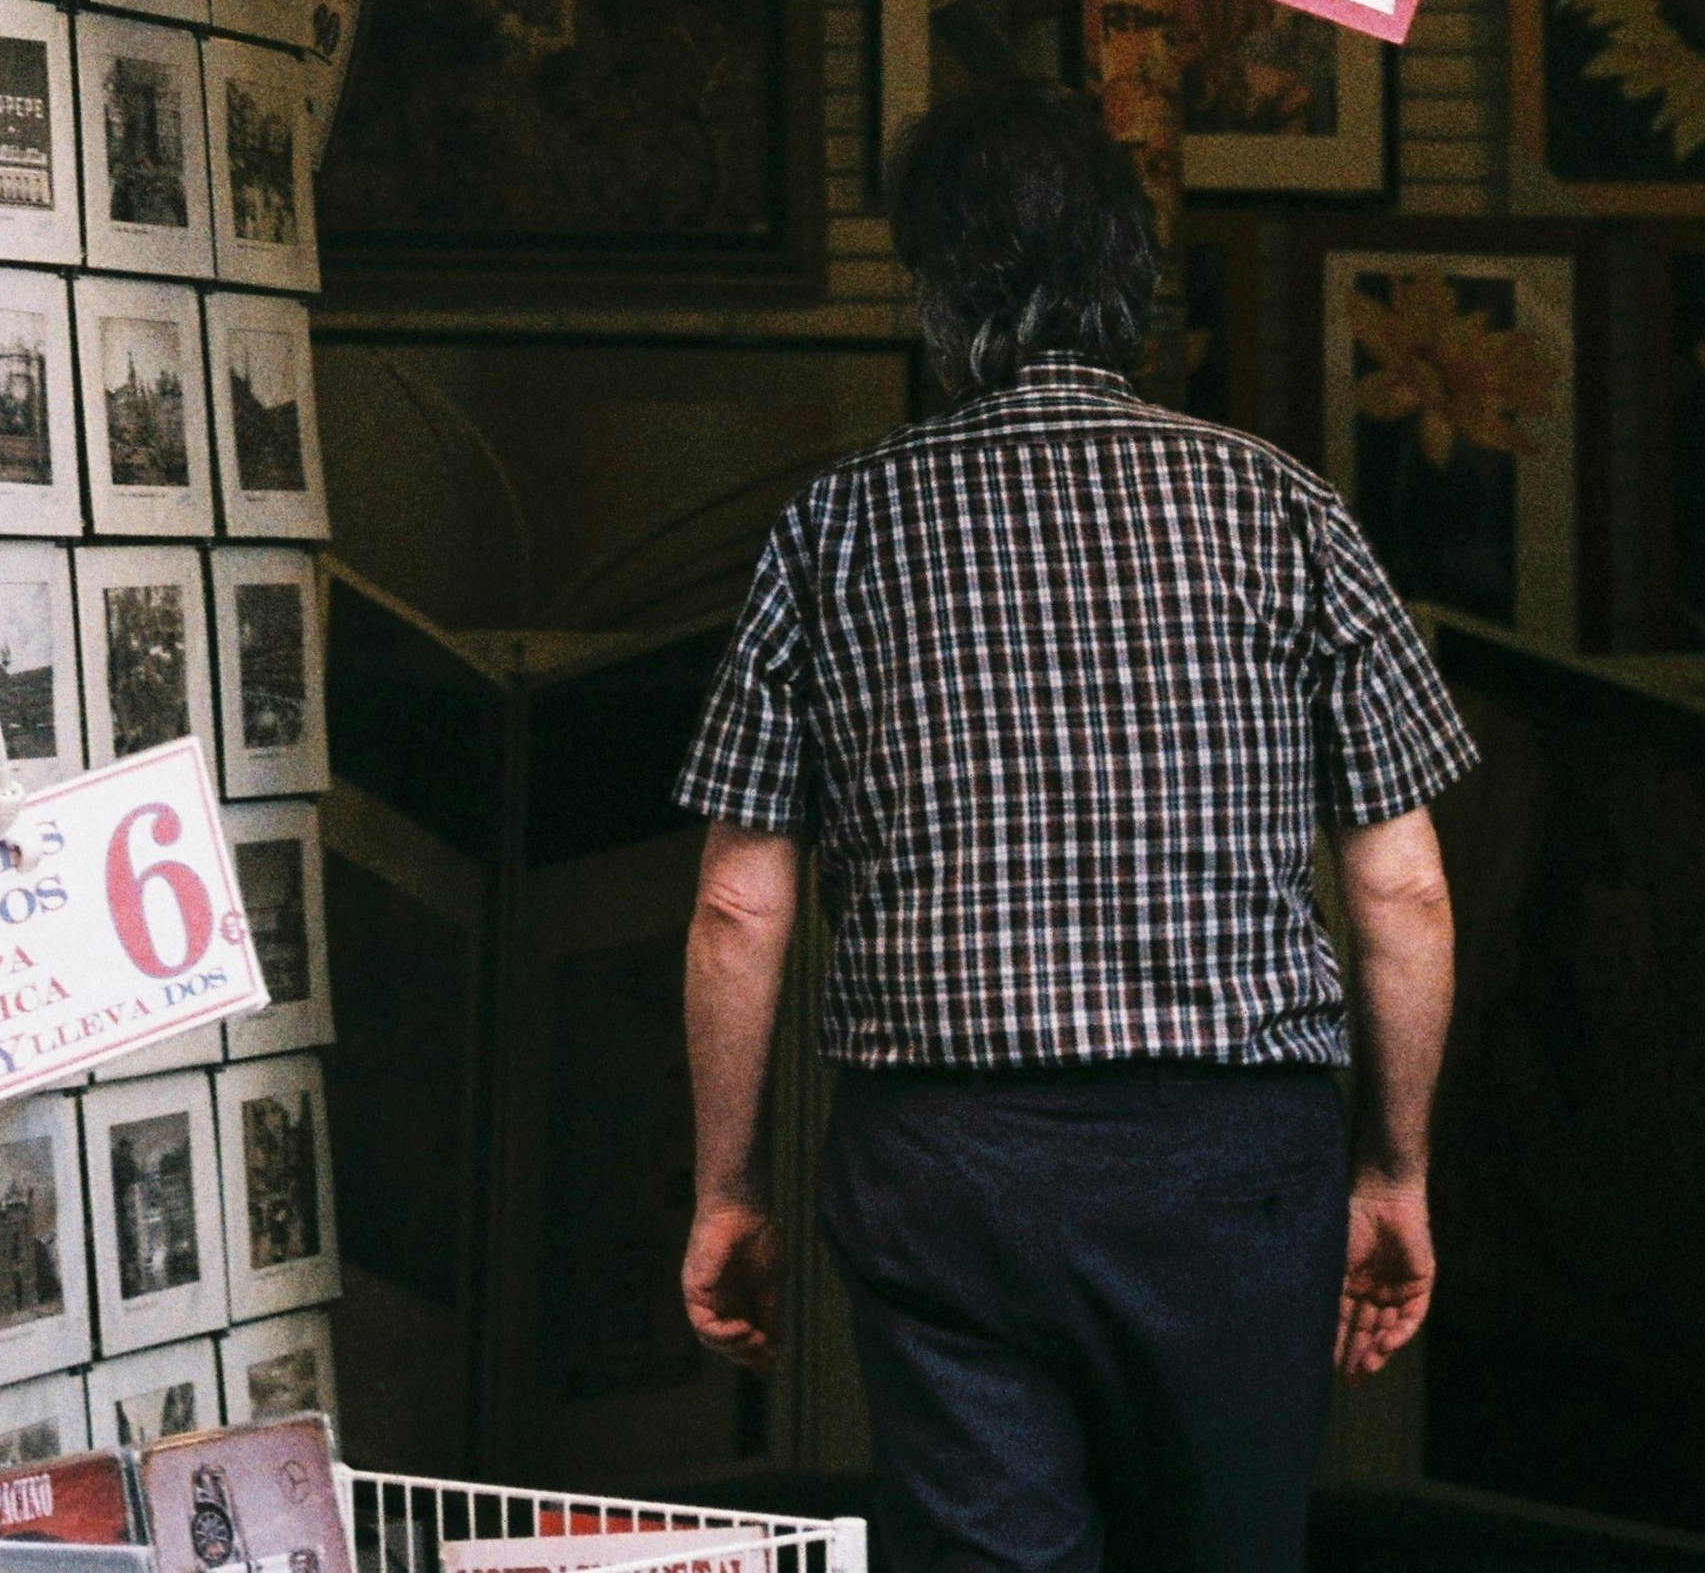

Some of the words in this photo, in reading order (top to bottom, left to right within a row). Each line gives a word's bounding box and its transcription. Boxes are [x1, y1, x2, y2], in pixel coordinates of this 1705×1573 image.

[104, 802, 214, 980] 6
[31, 997, 152, 1058] LLEVA
[161, 965, 228, 1008] DOS
